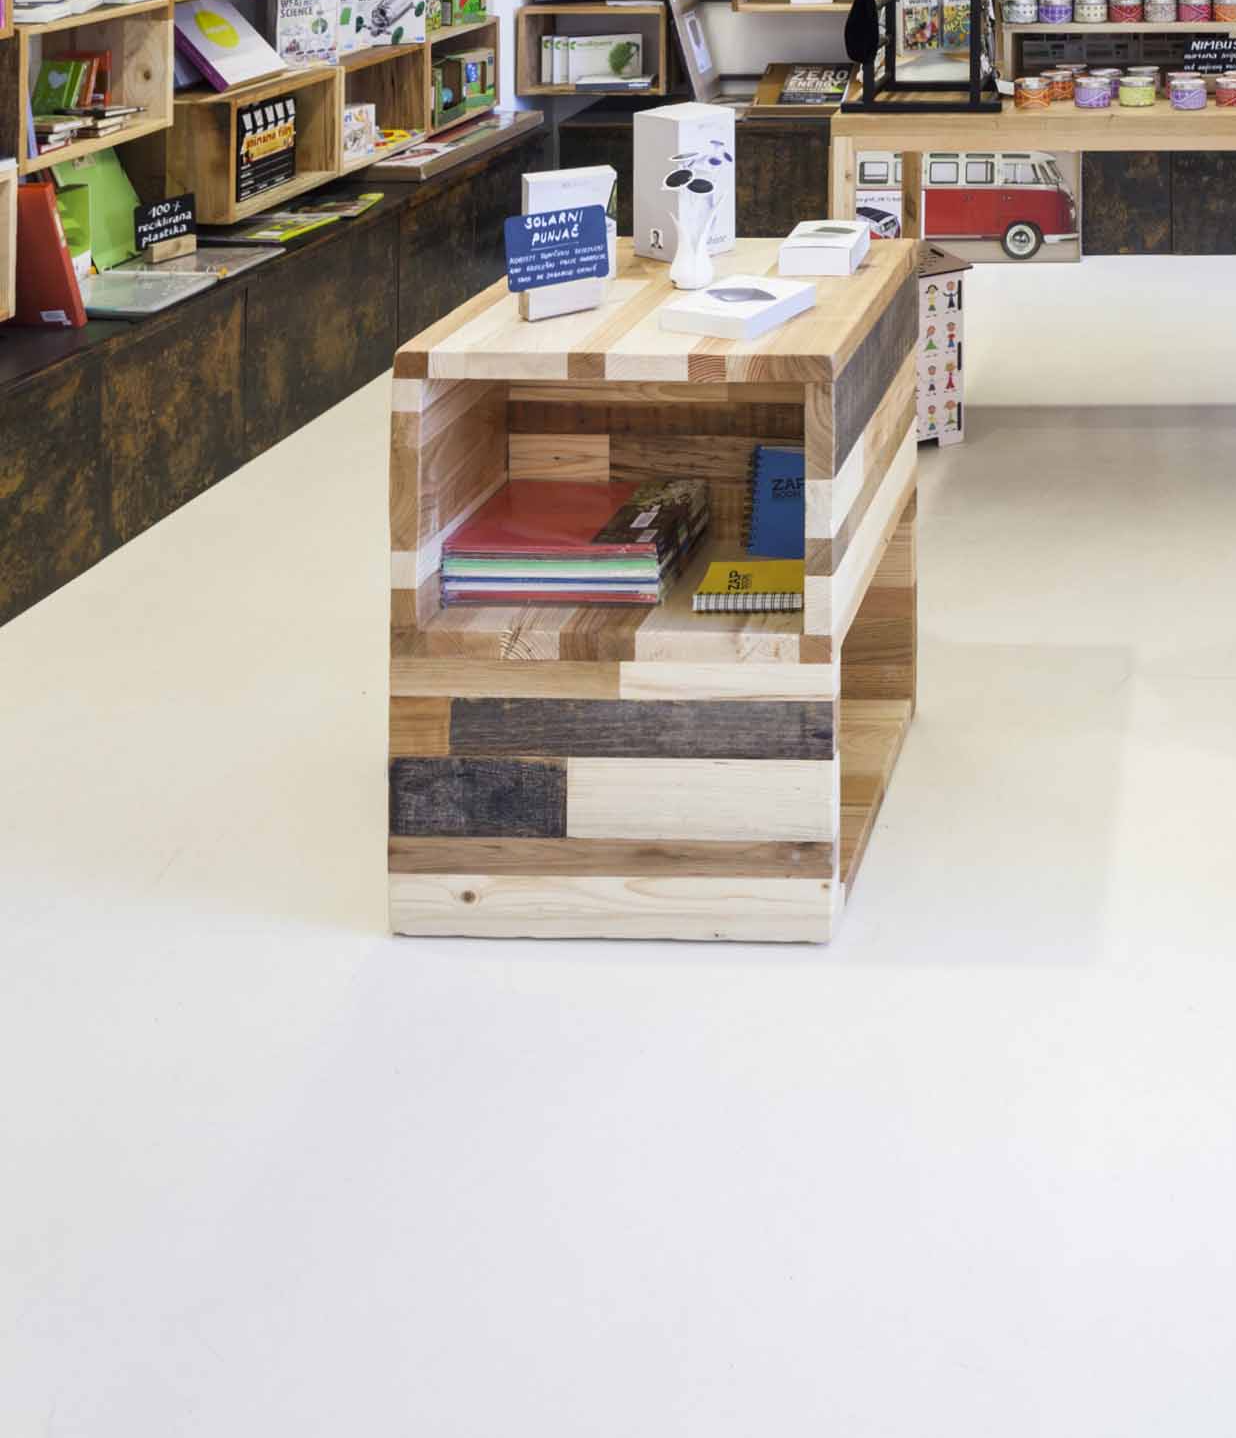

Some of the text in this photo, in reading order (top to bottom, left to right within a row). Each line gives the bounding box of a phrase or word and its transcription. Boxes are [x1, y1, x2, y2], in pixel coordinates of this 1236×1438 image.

[280, 7, 313, 19] SCIENCE
[791, 69, 849, 82] ZERO
[148, 203, 170, 218] 100
[524, 210, 583, 230] SOLARNI
[138, 210, 192, 233] reciklirana
[142, 224, 187, 248] plastika
[532, 224, 579, 246] PUNJAČ
[728, 570, 740, 590] ZAP
